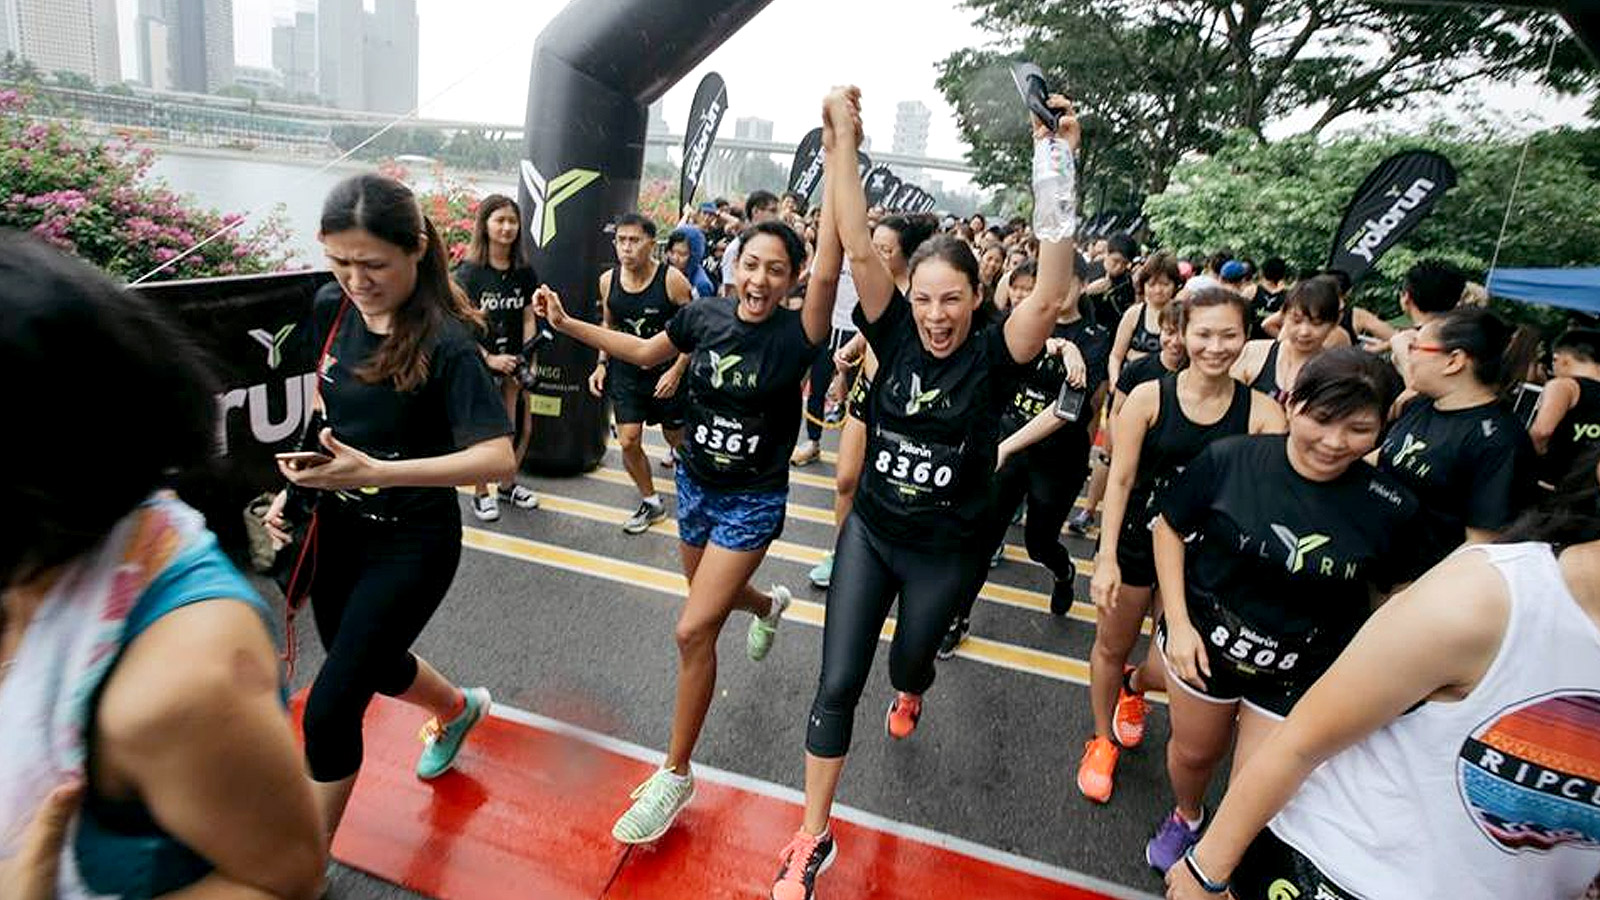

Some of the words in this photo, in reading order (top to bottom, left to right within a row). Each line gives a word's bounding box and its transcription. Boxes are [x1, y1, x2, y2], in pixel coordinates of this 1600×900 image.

[687, 101, 721, 185] yolorun
[1349, 177, 1436, 262] yolorun
[694, 424, 760, 454] 8361
[875, 450, 952, 487] 8360
[1210, 625, 1299, 670] 8508
